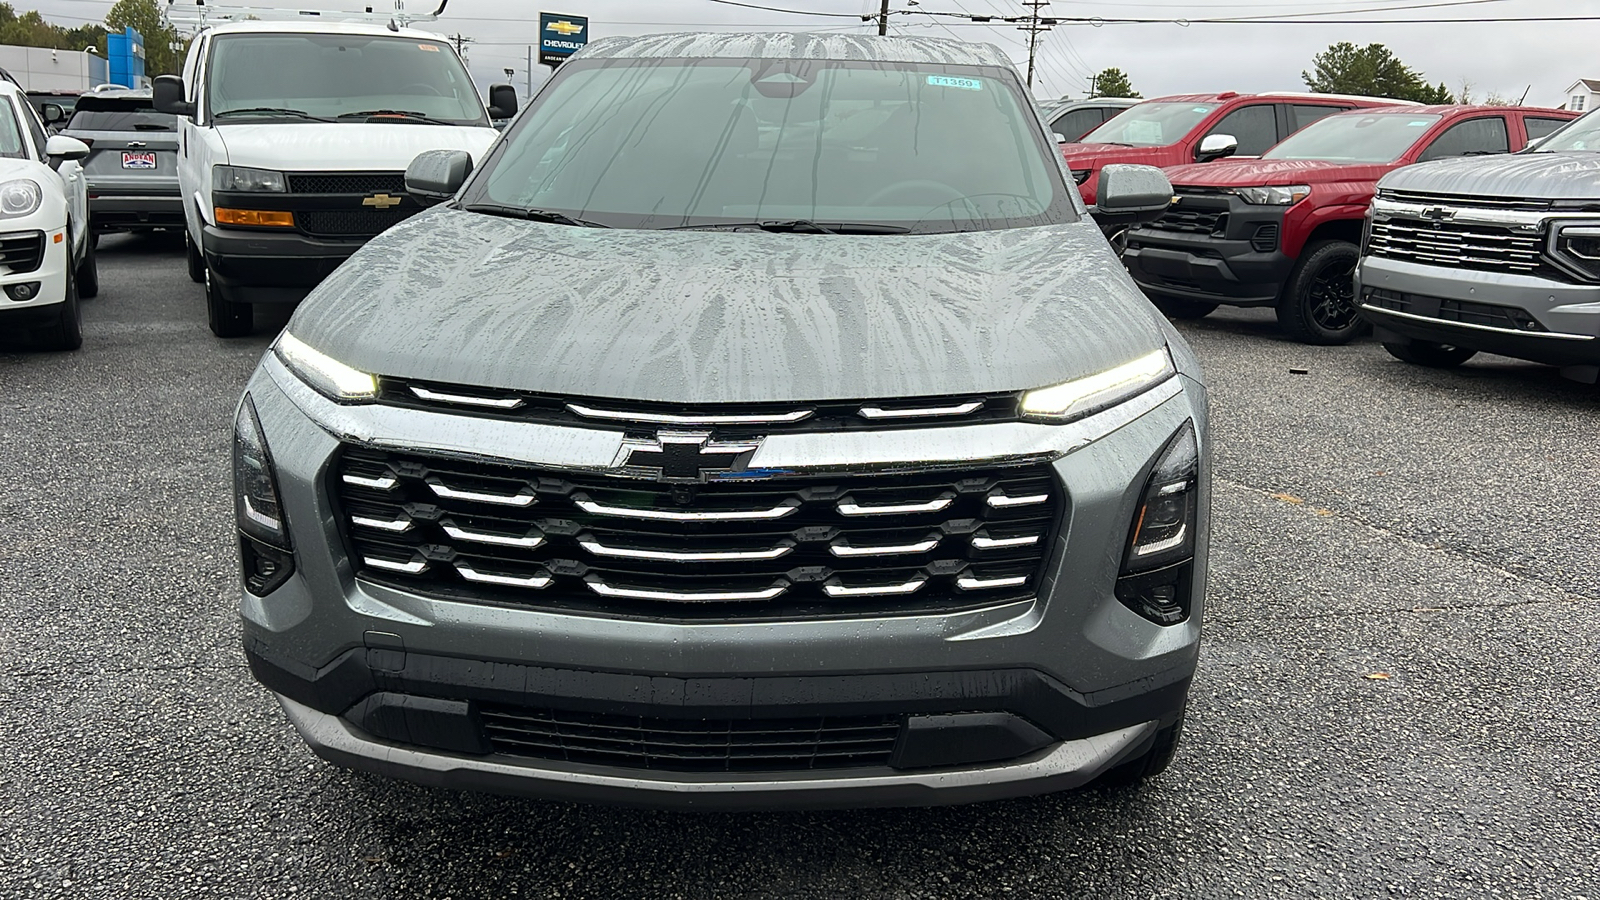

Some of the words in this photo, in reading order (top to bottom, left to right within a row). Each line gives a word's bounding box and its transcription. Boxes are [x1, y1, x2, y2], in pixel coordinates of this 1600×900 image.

[543, 39, 584, 49] CHEVROLET
[933, 77, 973, 87] T1359
[124, 154, 154, 163] ANDEAN
